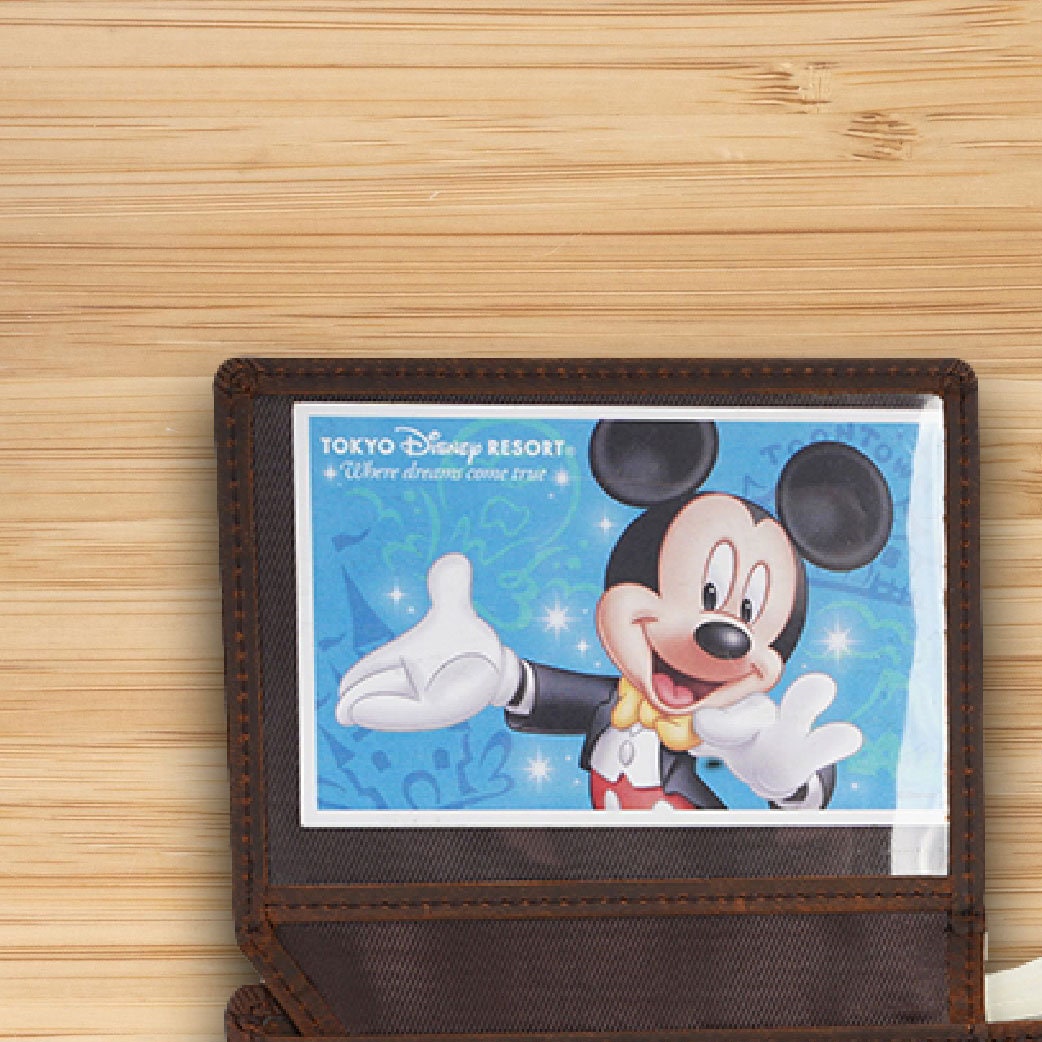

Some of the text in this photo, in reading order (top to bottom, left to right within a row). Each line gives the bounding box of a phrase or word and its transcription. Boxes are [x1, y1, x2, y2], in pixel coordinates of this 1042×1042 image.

[320, 426, 566, 465] TOKYO Disney RESORT
[340, 459, 548, 482] Where dreams come true
